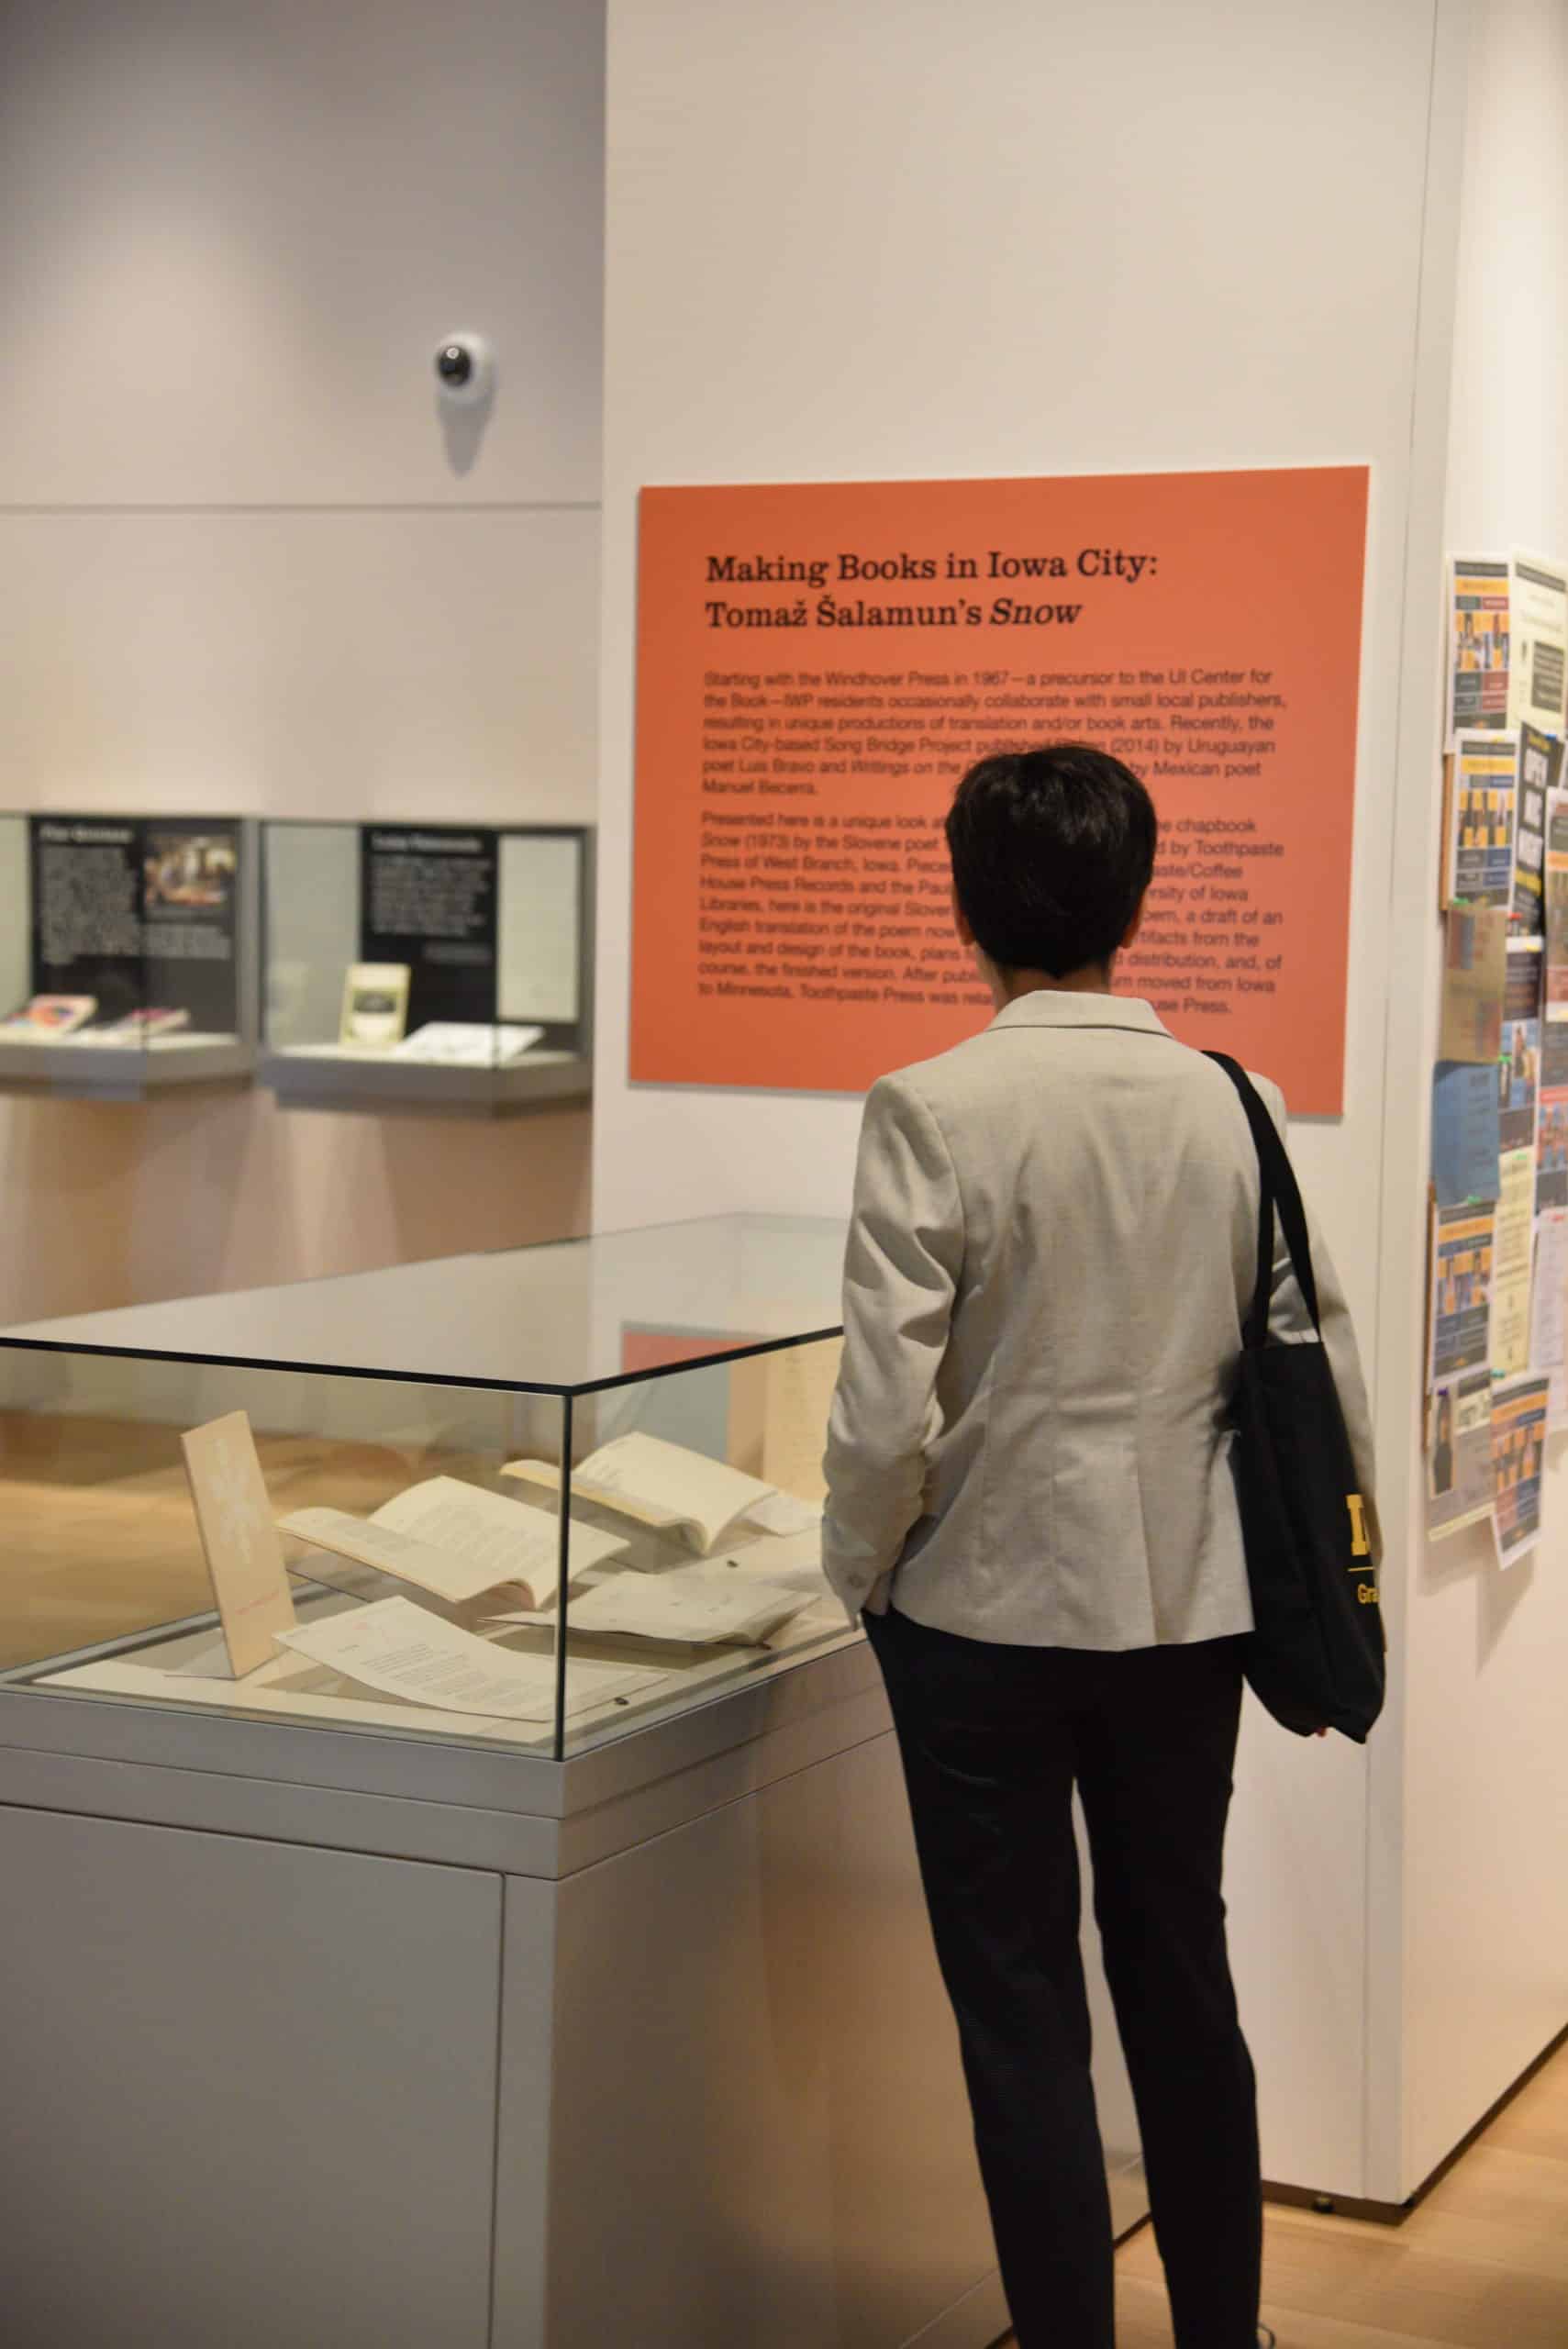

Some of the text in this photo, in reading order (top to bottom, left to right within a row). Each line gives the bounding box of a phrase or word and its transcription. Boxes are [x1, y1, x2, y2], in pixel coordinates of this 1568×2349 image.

[706, 549, 1158, 589] Making Books in Iowa City:
[705, 599, 807, 629] Tomaž
[988, 597, 1084, 626] Snow
[705, 671, 760, 690] Starting
[764, 674, 794, 685] with
[798, 674, 822, 686] the
[825, 672, 903, 686] Windhover
[908, 671, 950, 686] Press
[954, 674, 968, 685] in
[1040, 674, 1113, 686] precursor
[1118, 672, 1133, 685] to
[1140, 671, 1164, 685] the
[1190, 668, 1245, 685] Center
[1250, 668, 1273, 685] for
[705, 695, 727, 707] the
[817, 696, 884, 708] residents
[888, 694, 979, 711] occasionally
[984, 694, 1070, 708] collaborate
[1074, 694, 1106, 707] with
[1111, 693, 1151, 707] small
[1157, 694, 1193, 707] local
[1198, 693, 1285, 709] publishers,
[704, 716, 764, 733] resulting
[768, 718, 781, 729] in
[785, 718, 834, 731] unique
[837, 717, 926, 732] productions
[929, 716, 945, 730] of
[949, 717, 1028, 730] translation
[1086, 718, 1125, 731] book
[1171, 715, 1242, 731] Recently,
[1248, 716, 1273, 730] the
[704, 738, 736, 751] Iowa
[825, 737, 862, 755] Song
[866, 737, 916, 755] Bridge
[919, 737, 972, 755] Project
[1110, 738, 1158, 755] (2014)
[1162, 738, 1183, 756] by
[1188, 739, 1275, 756] Uruguayan
[703, 761, 734, 774] poet
[819, 761, 847, 774] and
[913, 763, 933, 774] on
[938, 760, 960, 774] the
[1152, 761, 1220, 775] Mexican
[1225, 763, 1261, 778] poet
[703, 779, 754, 793] Manuel
[702, 811, 774, 827] Presented
[779, 815, 809, 827] here
[813, 816, 825, 828] is
[829, 817, 839, 828] a
[842, 817, 892, 829] unique
[895, 817, 927, 829] look
[1176, 819, 1256, 835] chapbook
[702, 832, 740, 848] Snow
[793, 836, 810, 852] by
[816, 836, 838, 849] the
[843, 835, 901, 851] Slovene
[905, 838, 939, 852] poet
[1170, 841, 1191, 858] by
[1195, 840, 1284, 859] Toothpaste
[701, 853, 740, 869] Press
[744, 855, 761, 870] of
[763, 856, 797, 870] West
[700, 877, 746, 890] House
[750, 876, 790, 891] Press
[794, 876, 855, 893] Records
[859, 881, 886, 894] and
[891, 881, 913, 895] the
[1189, 885, 1206, 901] of
[1210, 887, 1248, 901] Iowa
[769, 900, 801, 912] here
[804, 902, 817, 913] is
[820, 900, 844, 915] the
[848, 903, 900, 918] original
[1186, 910, 1196, 923] a
[1200, 908, 1237, 924] draft
[1241, 910, 1259, 925] of
[1262, 912, 1283, 925] an
[699, 918, 750, 936] English
[754, 920, 829, 935] translation
[833, 921, 848, 936] of
[852, 923, 873, 937] the
[878, 925, 920, 939] poem
[926, 926, 954, 939] now
[1193, 931, 1229, 946] from
[1233, 932, 1260, 947] the
[699, 941, 742, 955] layout
[746, 942, 773, 954] and
[777, 942, 825, 960] design
[829, 943, 844, 957] of
[848, 944, 871, 958] the
[920, 948, 961, 962] plans
[1128, 952, 1220, 969] distribution,
[1265, 954, 1282, 971] of
[754, 963, 778, 976] the
[783, 963, 838, 978] finished
[903, 966, 937, 981] After
[1137, 976, 1192, 991] moved
[1195, 976, 1233, 991] from
[1238, 976, 1275, 993] Iowa
[698, 983, 713, 996] to
[800, 984, 879, 1002] Toothpaste
[883, 986, 925, 1003] Press
[929, 993, 959, 1005] was
